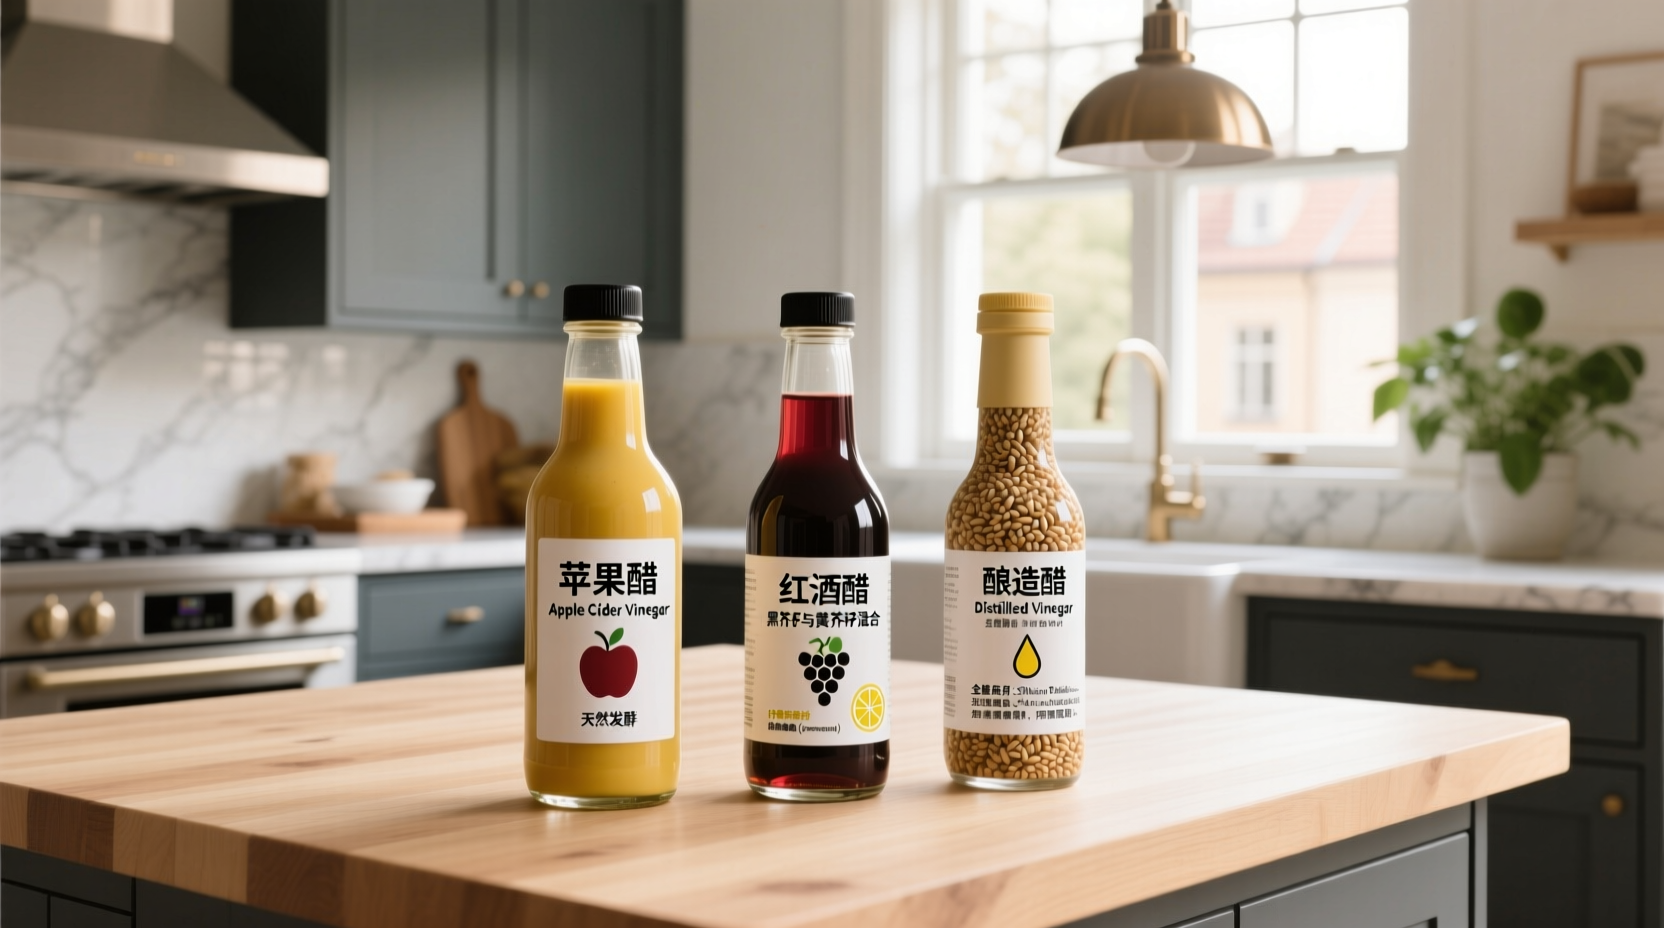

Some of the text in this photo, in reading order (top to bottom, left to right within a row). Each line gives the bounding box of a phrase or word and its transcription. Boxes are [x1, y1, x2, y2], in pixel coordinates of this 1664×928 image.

[559, 561, 657, 596] 苹果醋
[779, 573, 869, 605] 红酒醋
[983, 565, 1066, 596] 酿造醋
[548, 603, 670, 620] Apple Cider Vinegar
[1032, 601, 1073, 617] Vinegar
